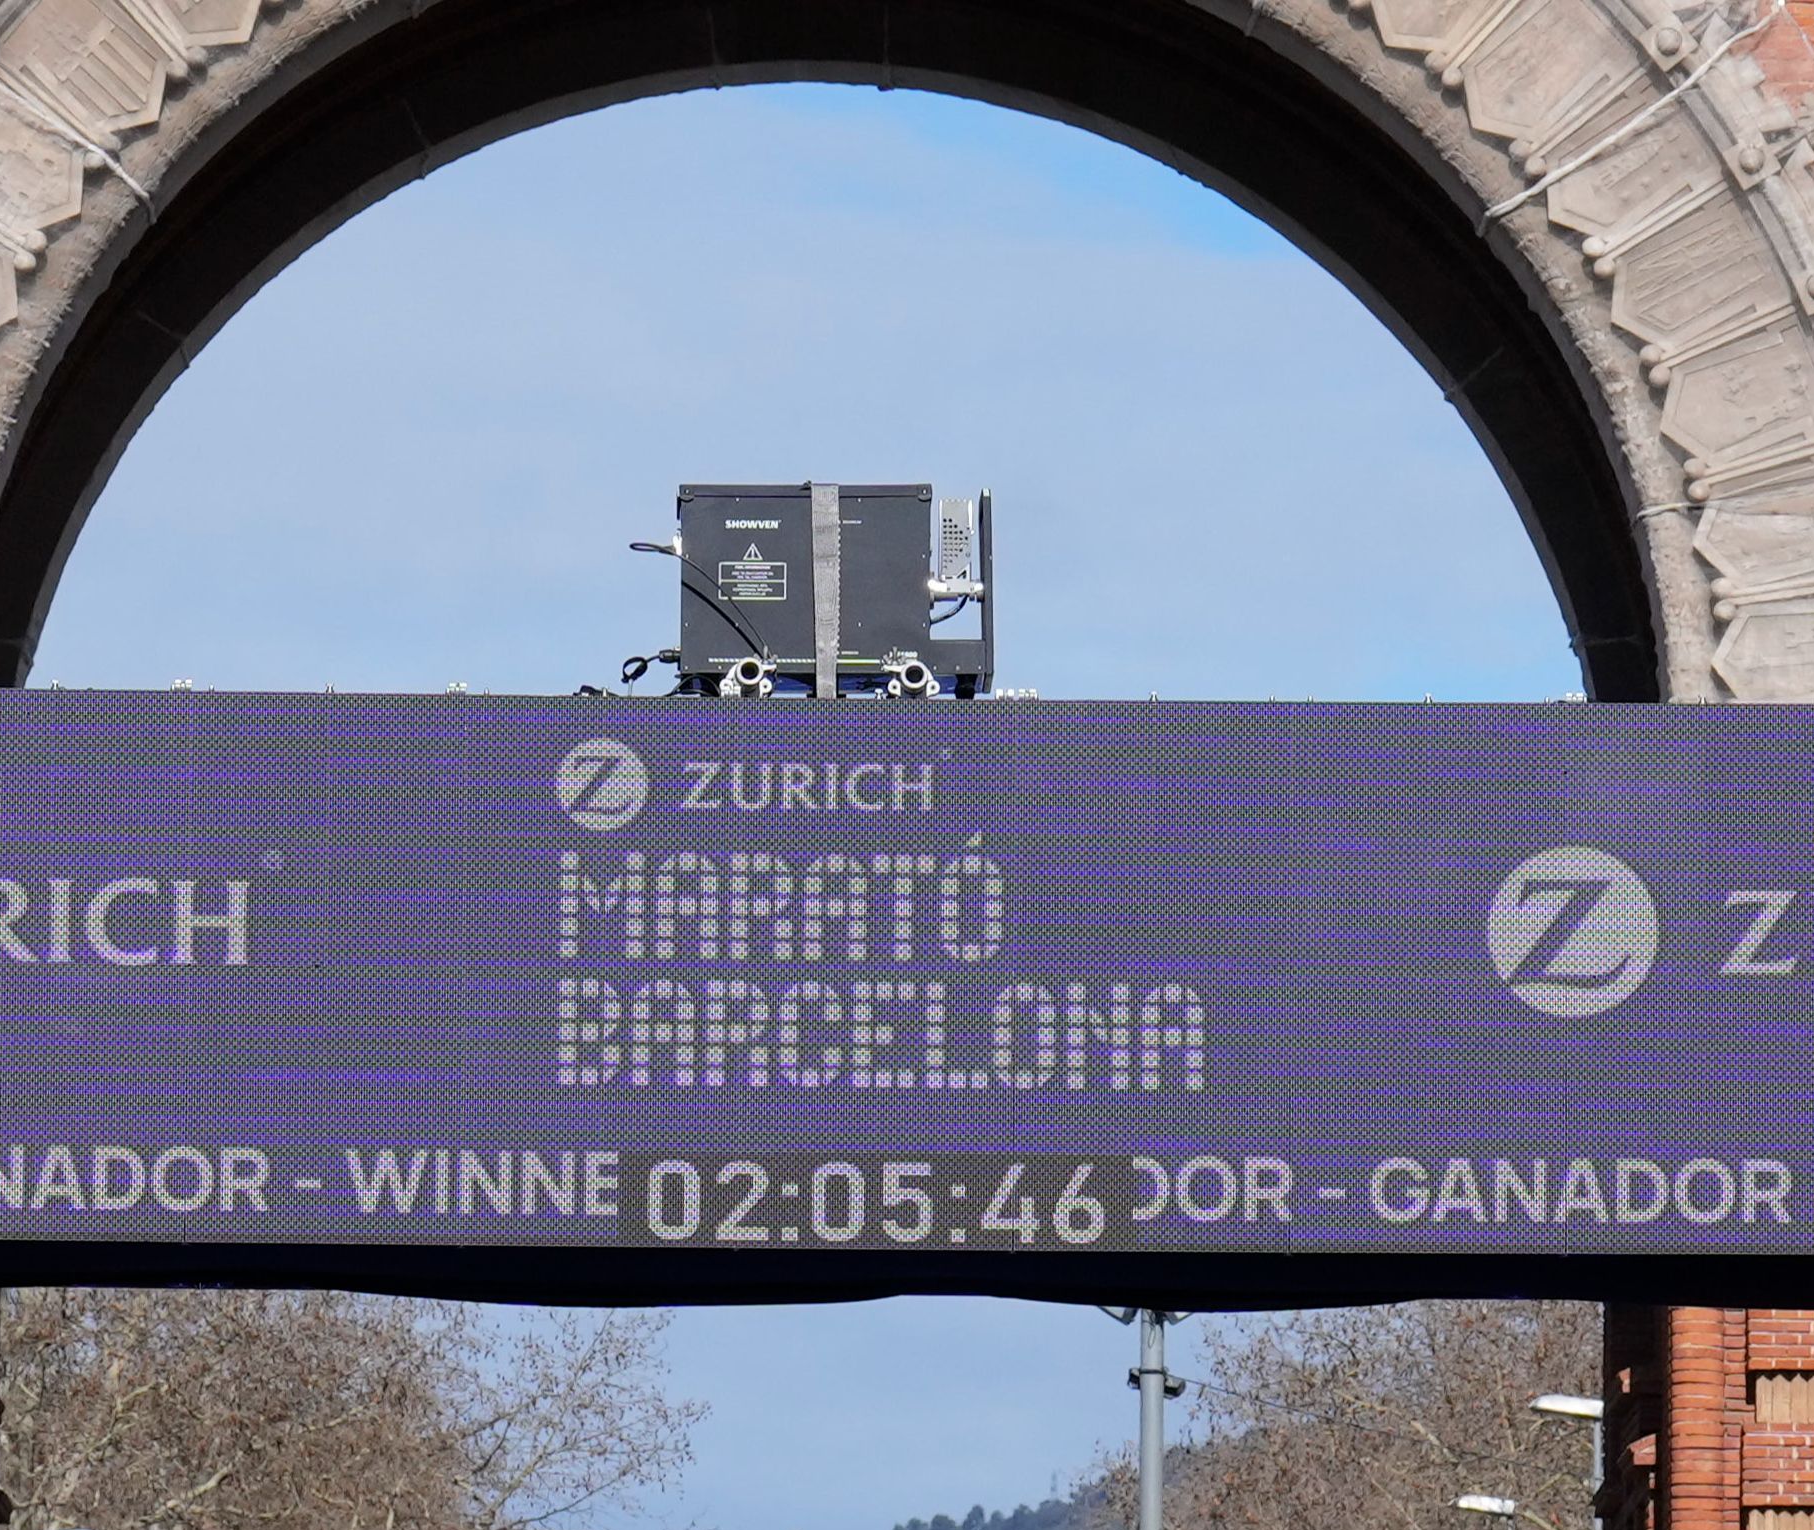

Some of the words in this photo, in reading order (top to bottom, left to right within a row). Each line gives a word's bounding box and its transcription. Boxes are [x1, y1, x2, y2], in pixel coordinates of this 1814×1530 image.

[725, 519, 779, 530] SHOWVEN
[681, 762, 935, 812] ZURICH
[559, 831, 1003, 962] MARATÓ
[559, 980, 1205, 1090] BARCELONA
[345, 1147, 618, 1217] WINNE
[647, 1159, 1105, 1246] 02:05:46
[1371, 1156, 1793, 1225] GANADOR
